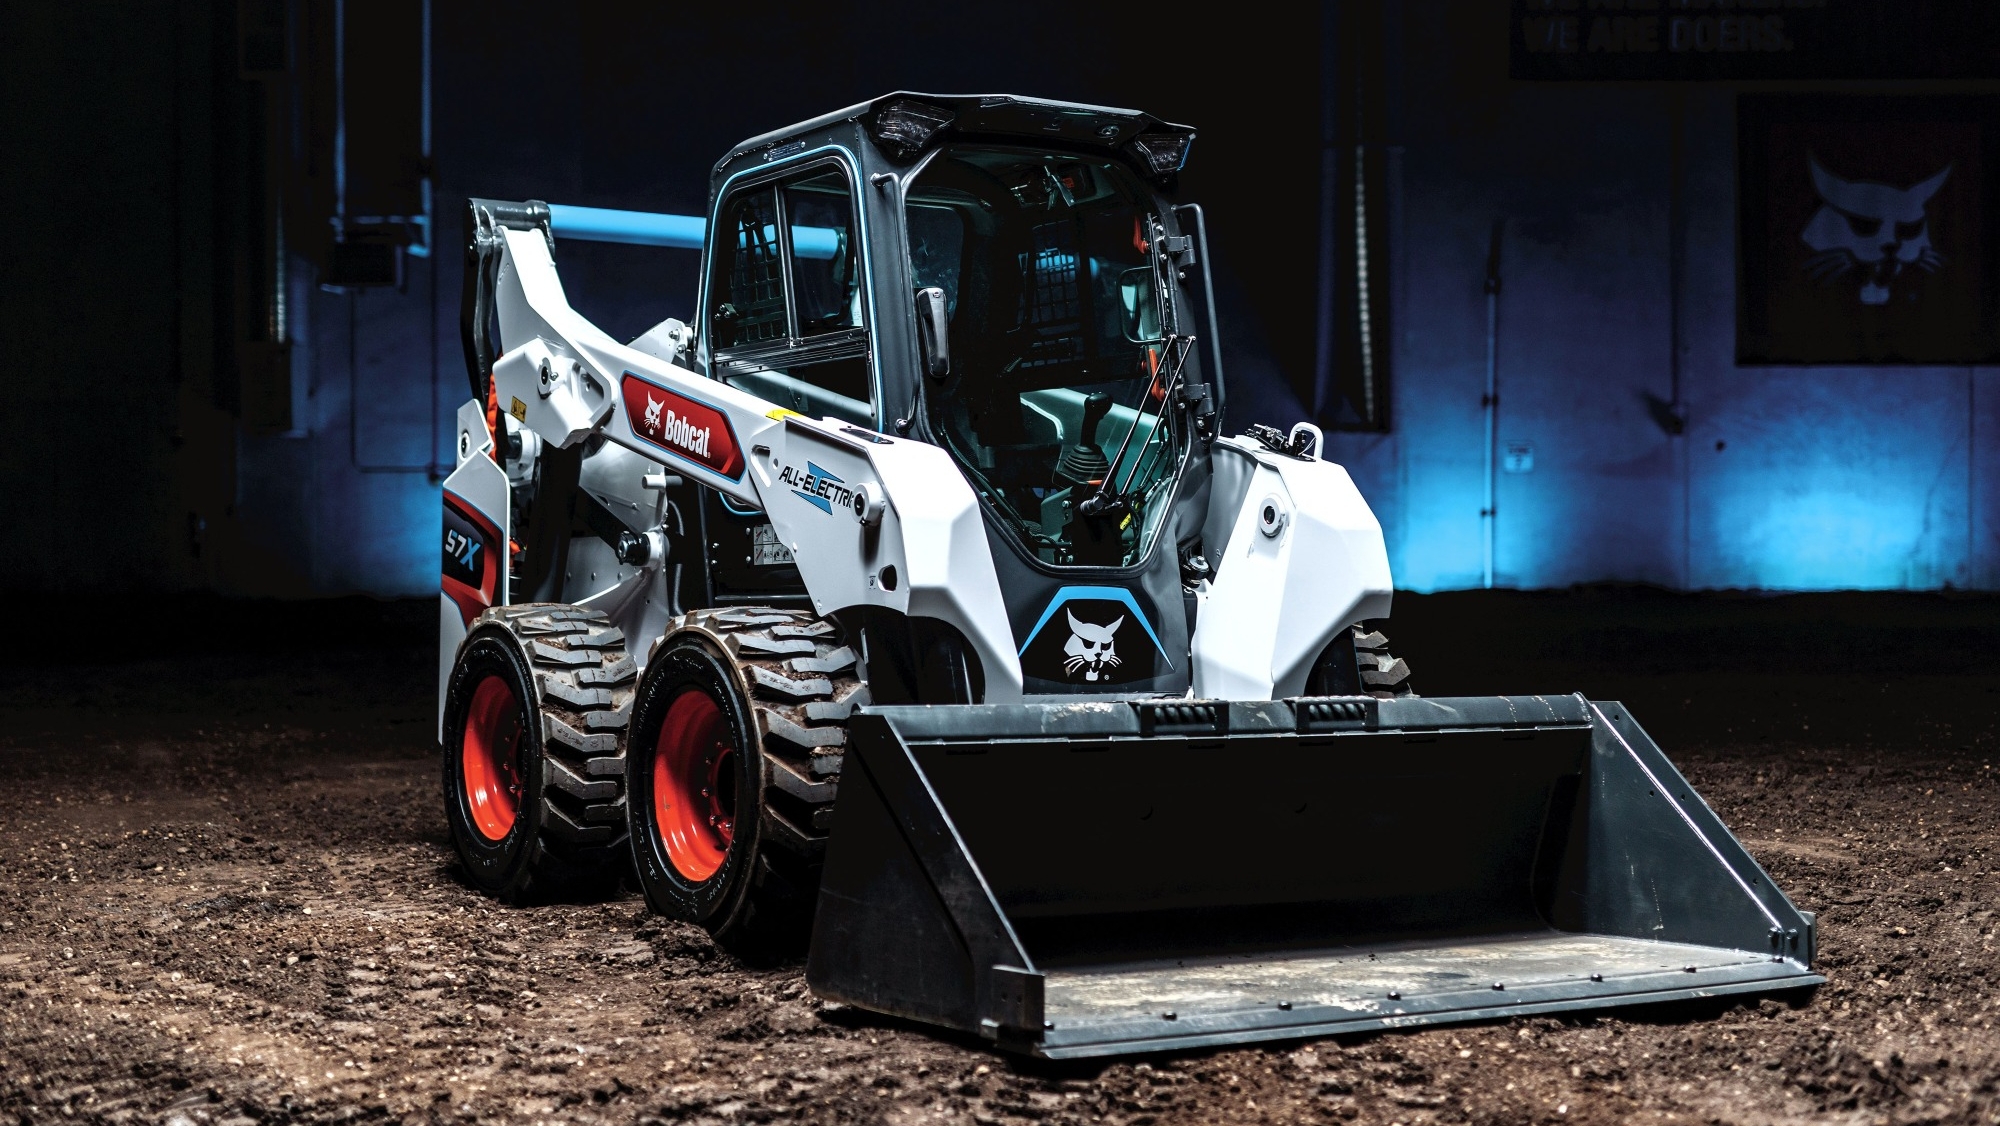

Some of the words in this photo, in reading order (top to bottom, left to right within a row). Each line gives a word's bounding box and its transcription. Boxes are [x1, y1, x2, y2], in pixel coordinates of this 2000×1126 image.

[1524, 17, 1577, 51] WE
[1588, 17, 1658, 51] ARE
[664, 409, 710, 458] Bobcat
[445, 529, 481, 571] S7X
